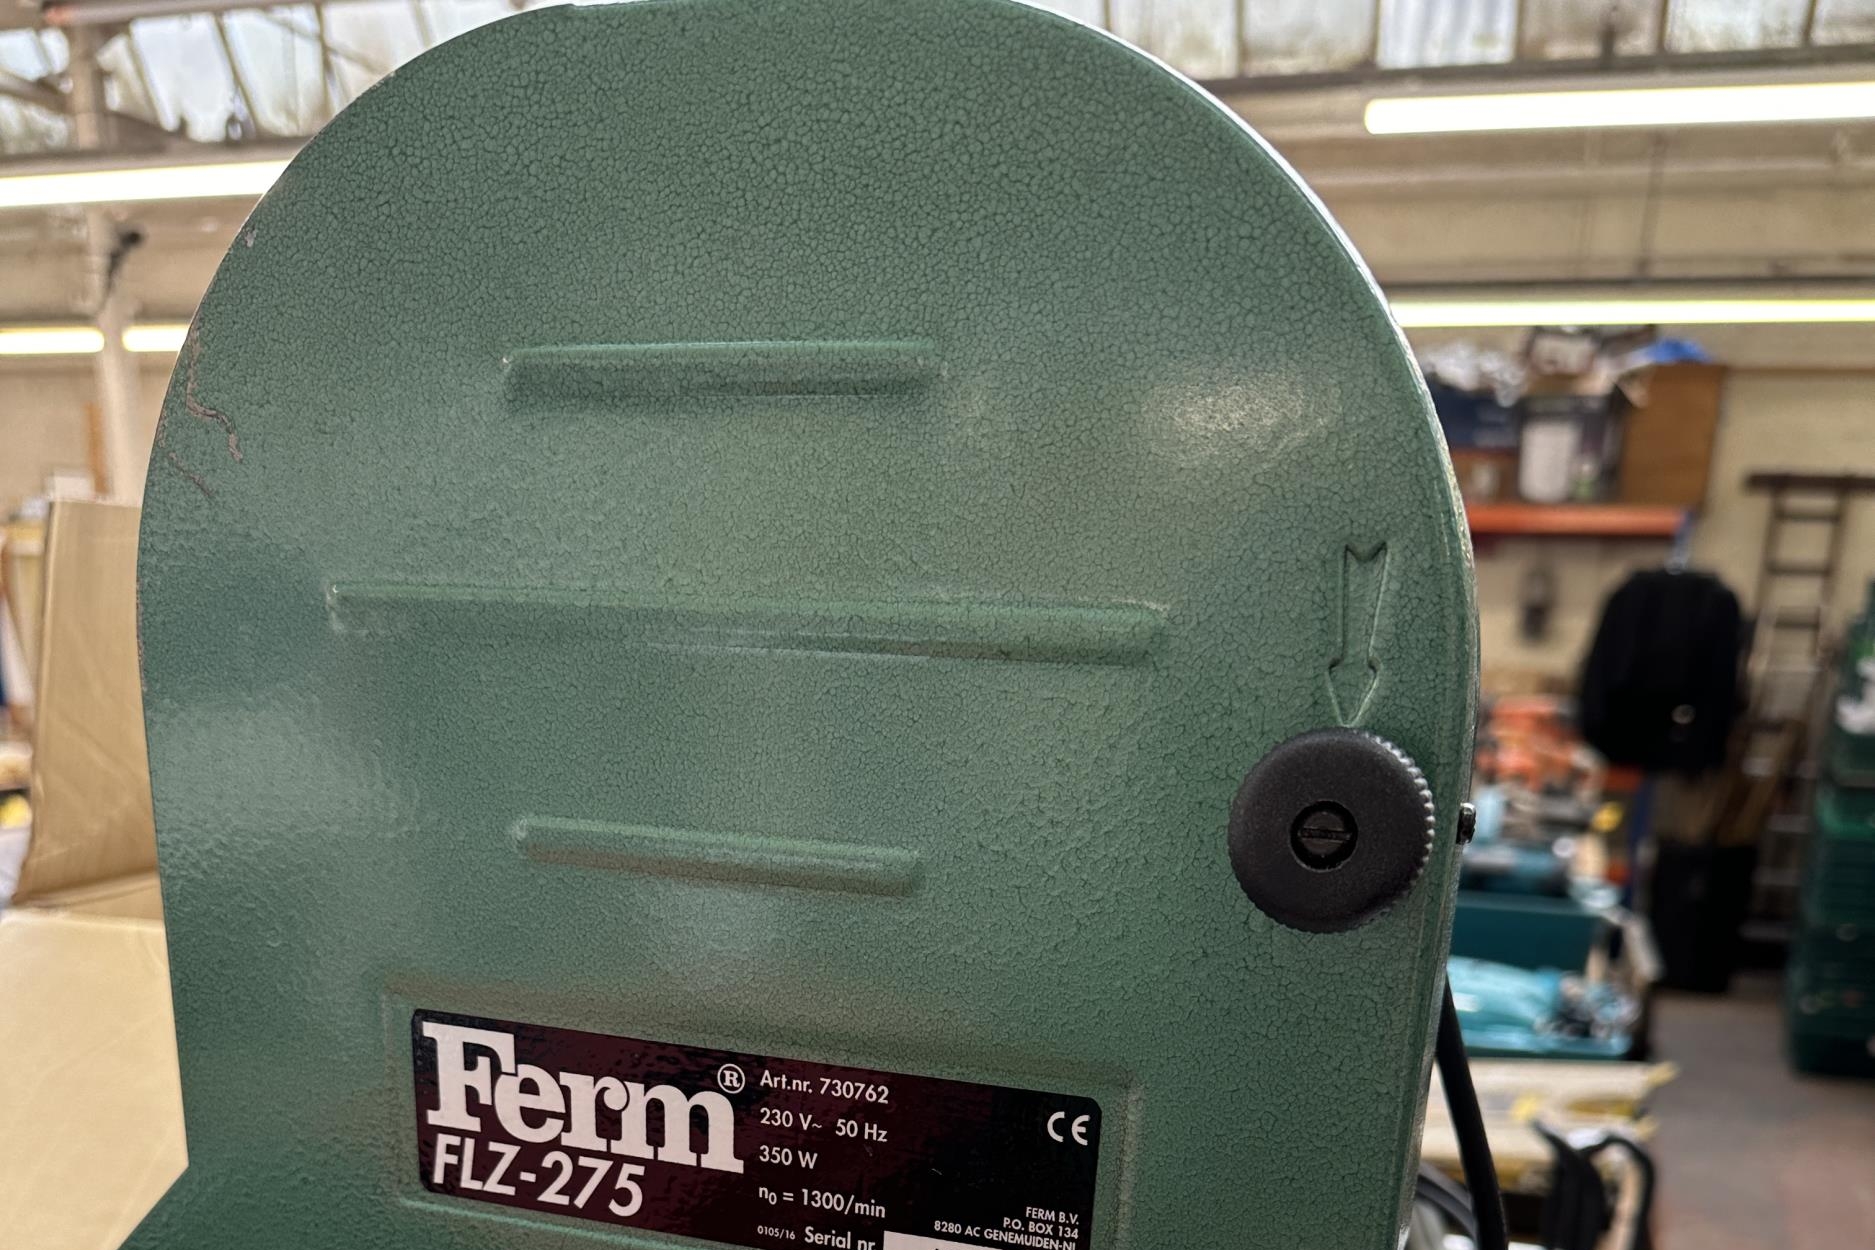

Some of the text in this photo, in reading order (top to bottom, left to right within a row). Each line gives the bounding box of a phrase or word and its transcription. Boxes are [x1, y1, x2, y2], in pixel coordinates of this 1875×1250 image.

[422, 1021, 744, 1174] Ferm
[759, 1069, 889, 1104] Art.nr. 730762
[760, 1107, 793, 1128] 230
[836, 1119, 859, 1138] 50
[864, 1123, 888, 1142] Hz
[1047, 1111, 1090, 1146] CE
[759, 1145, 818, 1169] 350 W
[433, 1133, 645, 1217] FLZ-275
[802, 1188, 886, 1219] 1300/min
[1026, 1206, 1079, 1225] FERM B.V.
[757, 1225, 796, 1240] 0105/16
[804, 1226, 851, 1250] Serial
[934, 1220, 962, 1235] 8280
[964, 1225, 981, 1237] AC
[1003, 1217, 1079, 1239] P.O. BOX 134
